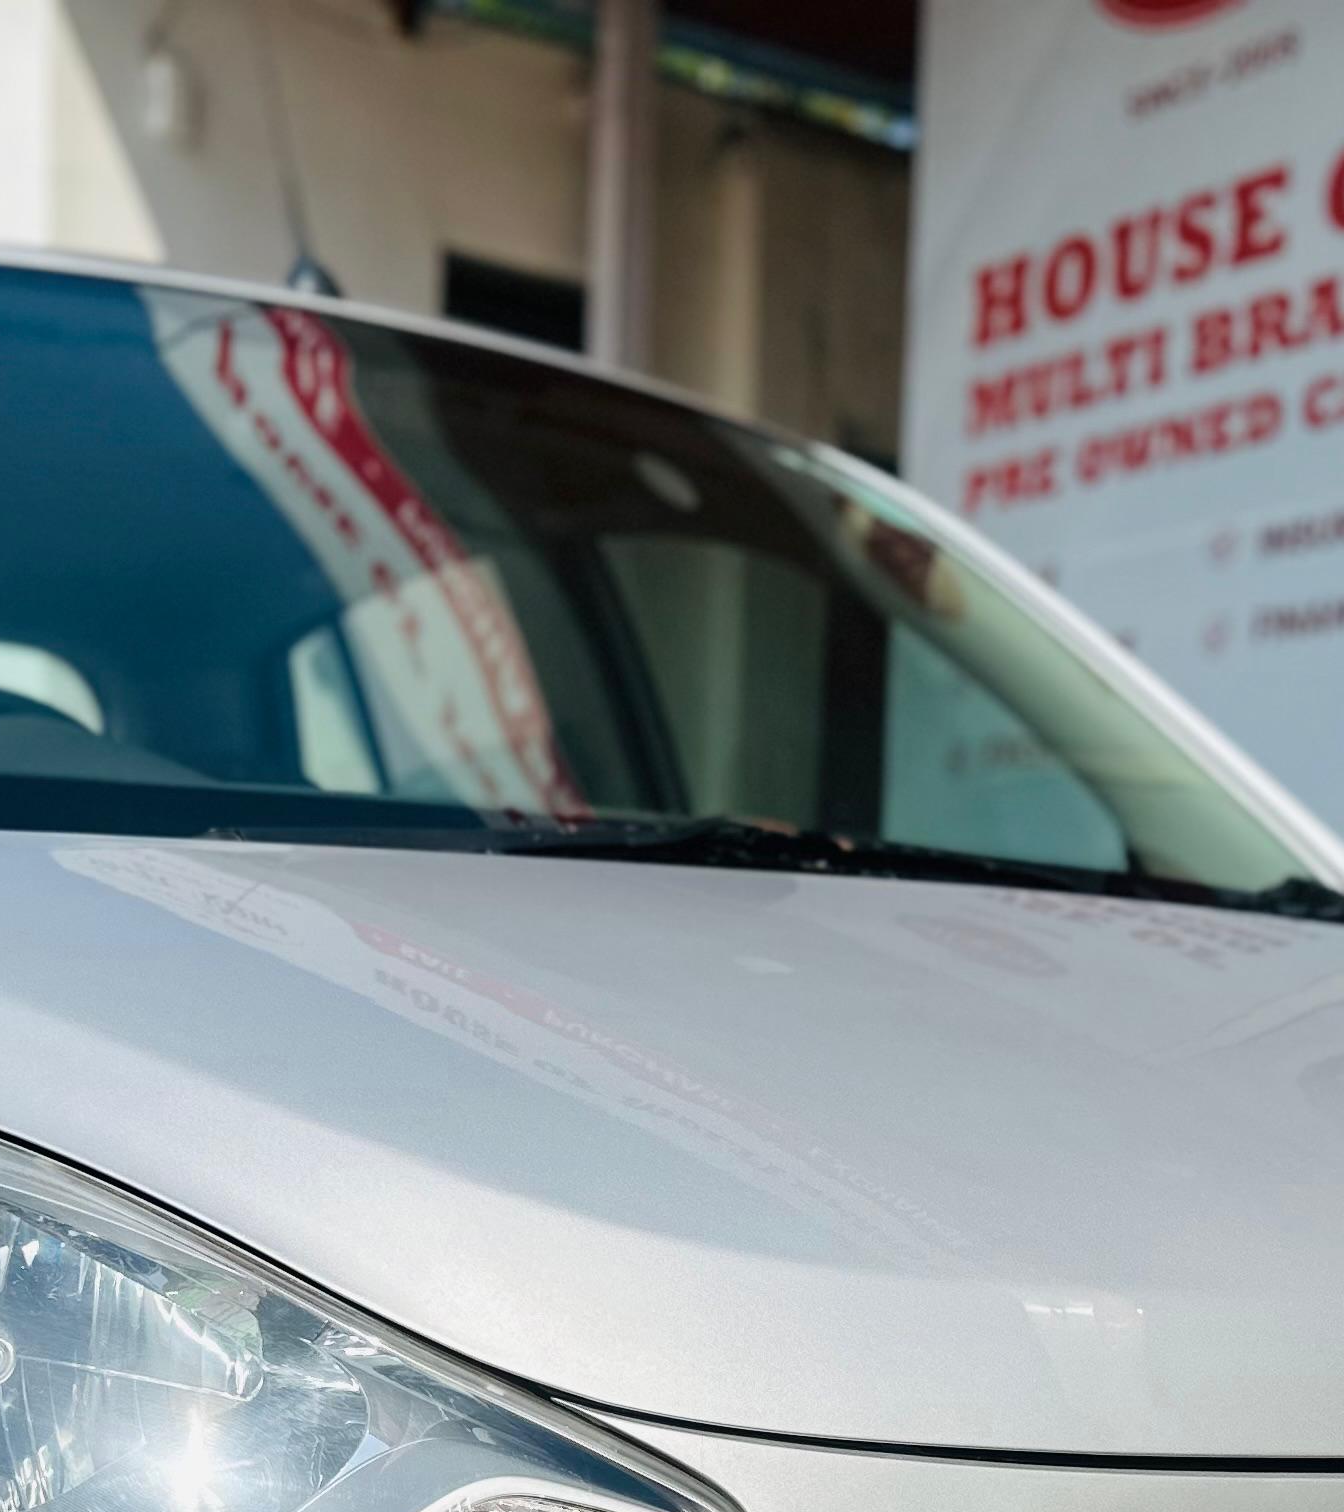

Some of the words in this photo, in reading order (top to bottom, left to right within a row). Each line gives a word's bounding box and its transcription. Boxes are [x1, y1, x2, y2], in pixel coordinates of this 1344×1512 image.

[972, 165, 1290, 350] HOUSE
[966, 328, 1167, 438] MULTI
[963, 448, 1059, 513] PRE
[1076, 391, 1283, 488] OWNED
